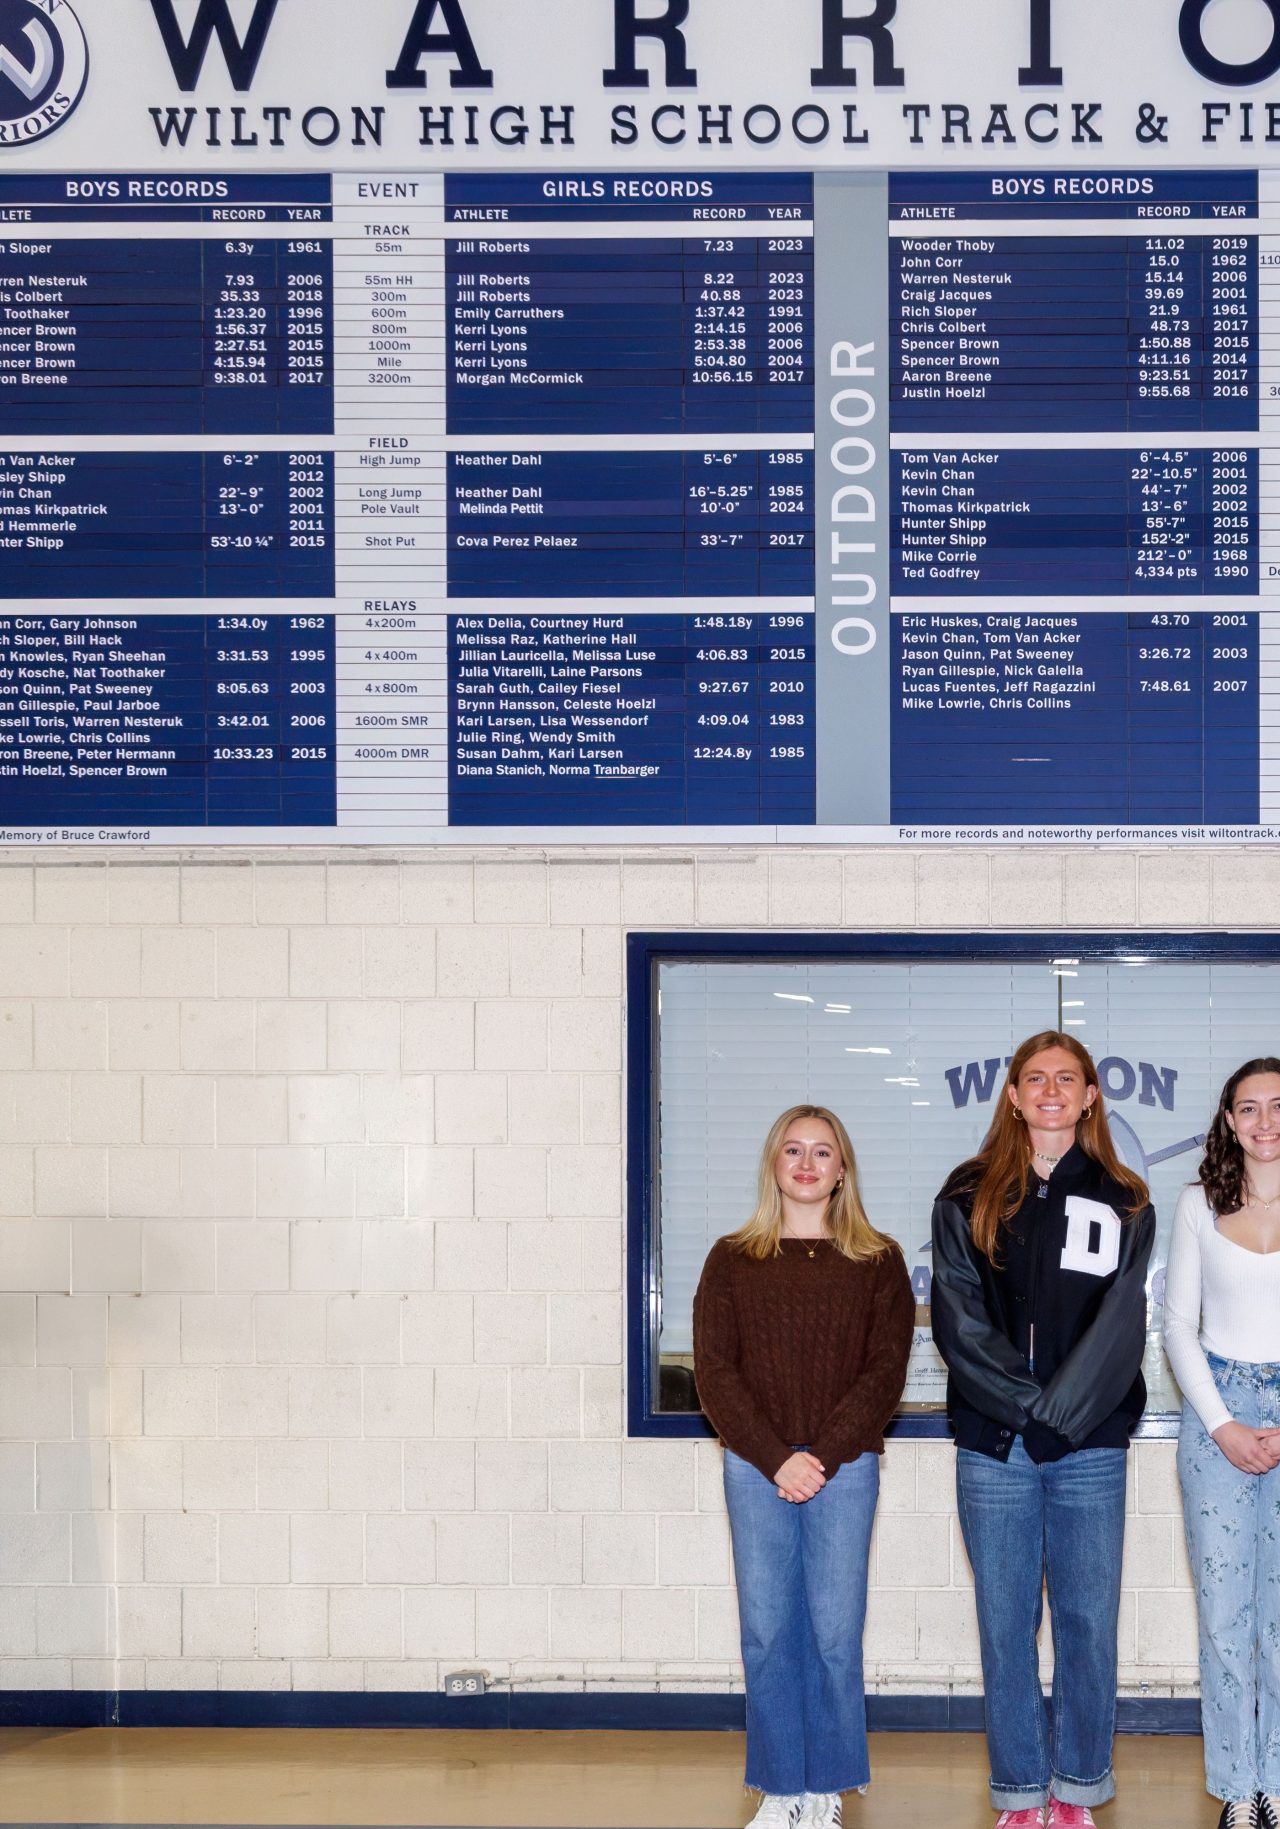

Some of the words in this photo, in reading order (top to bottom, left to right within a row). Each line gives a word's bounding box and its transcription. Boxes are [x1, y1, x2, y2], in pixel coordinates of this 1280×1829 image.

[148, 106, 385, 147] WILTON
[419, 106, 574, 145] HIGH
[611, 104, 868, 144] SCHOOL
[903, 103, 1102, 143] TRACK
[1136, 103, 1168, 143] &
[66, 181, 120, 197] BOYS
[129, 181, 228, 197] RECORDS
[358, 183, 419, 197] EVENT
[543, 181, 605, 197] GIRLS
[614, 181, 713, 197] RECORDS
[992, 178, 1045, 195] BOYS
[1054, 178, 1153, 194] RECORDS
[213, 209, 266, 220] RECORD
[287, 209, 321, 220] YEAR
[454, 209, 509, 220] ATHLETE
[364, 225, 410, 235] TRACK
[375, 242, 402, 252] 55m
[456, 242, 474, 253] Jill
[479, 241, 530, 252] Roberts
[704, 240, 733, 251] 7.23
[768, 239, 803, 251] 2023
[901, 240, 952, 251] Wooder
[956, 240, 995, 253] Thoby
[1146, 238, 1184, 250] 11.02
[1213, 238, 1248, 249] 2019
[456, 373, 505, 386] Morgan
[510, 372, 583, 384] McCormick
[693, 371, 753, 382] 10:56.15
[902, 387, 940, 398] Justin
[946, 387, 985, 398] Hoelzl
[360, 455, 386, 466] High
[389, 455, 421, 466] Jump
[830, 341, 876, 655] OUTDOOR
[35, 504, 107, 517] Kirkpatrick
[902, 518, 946, 528] Hunter
[949, 518, 986, 531] Shipp
[1135, 566, 1174, 578] 4,334
[1178, 567, 1197, 579] pts
[902, 616, 926, 627] Eric
[931, 616, 982, 628] Huskes,
[987, 616, 1021, 629] Craig
[1025, 616, 1077, 629] Jacques
[1151, 614, 1190, 625] 43.70
[549, 764, 590, 775] Norma
[593, 764, 660, 778] Tranbarger
[899, 828, 917, 838] For
[955, 829, 998, 838] records
[1002, 829, 1023, 838] and
[1028, 828, 1092, 840] noteworthy
[1097, 828, 1178, 840] performances
[1181, 828, 1205, 838] visit
[1060, 1196, 1121, 1277] D
